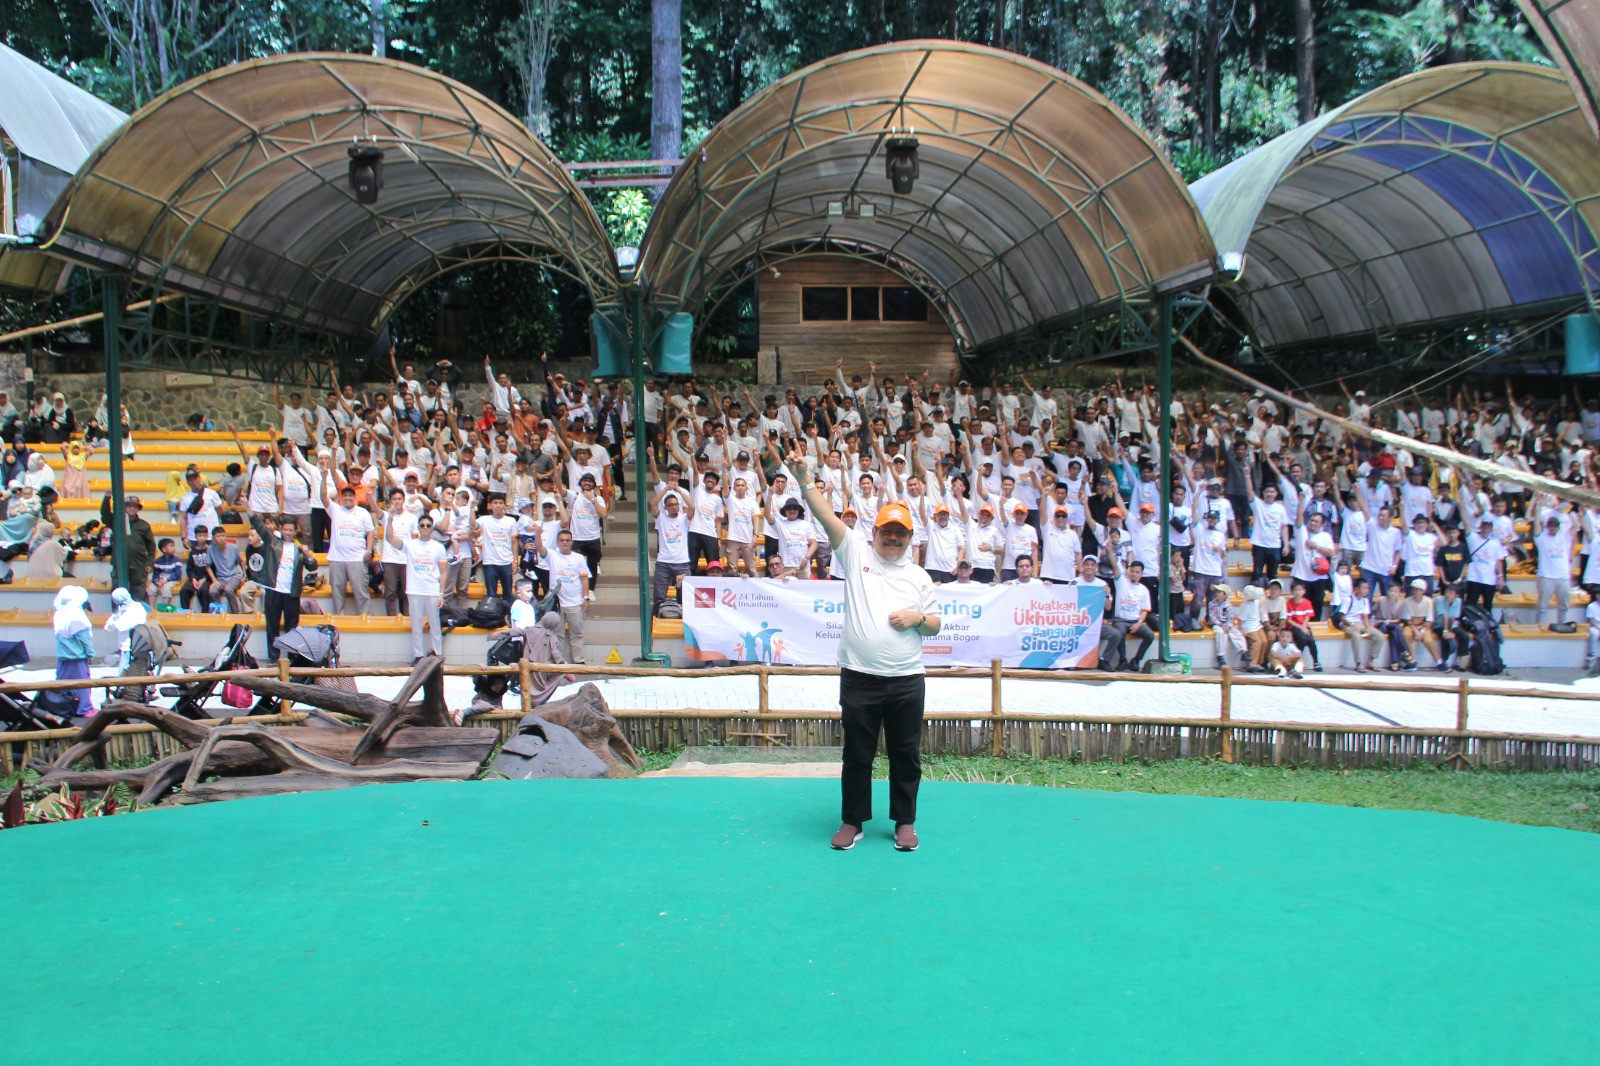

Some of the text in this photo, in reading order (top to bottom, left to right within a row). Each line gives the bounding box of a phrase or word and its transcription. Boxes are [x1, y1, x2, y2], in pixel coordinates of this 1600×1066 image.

[738, 592, 774, 601] 24 Tahun
[738, 600, 778, 609] Insantama
[1030, 599, 1077, 611] Kuatkan
[826, 621, 970, 631] Sila Akbar
[815, 630, 841, 639] Kelua
[953, 633, 980, 642] Bogor
[1032, 627, 1074, 640] Bangun
[1021, 635, 1079, 654] Sinergi
